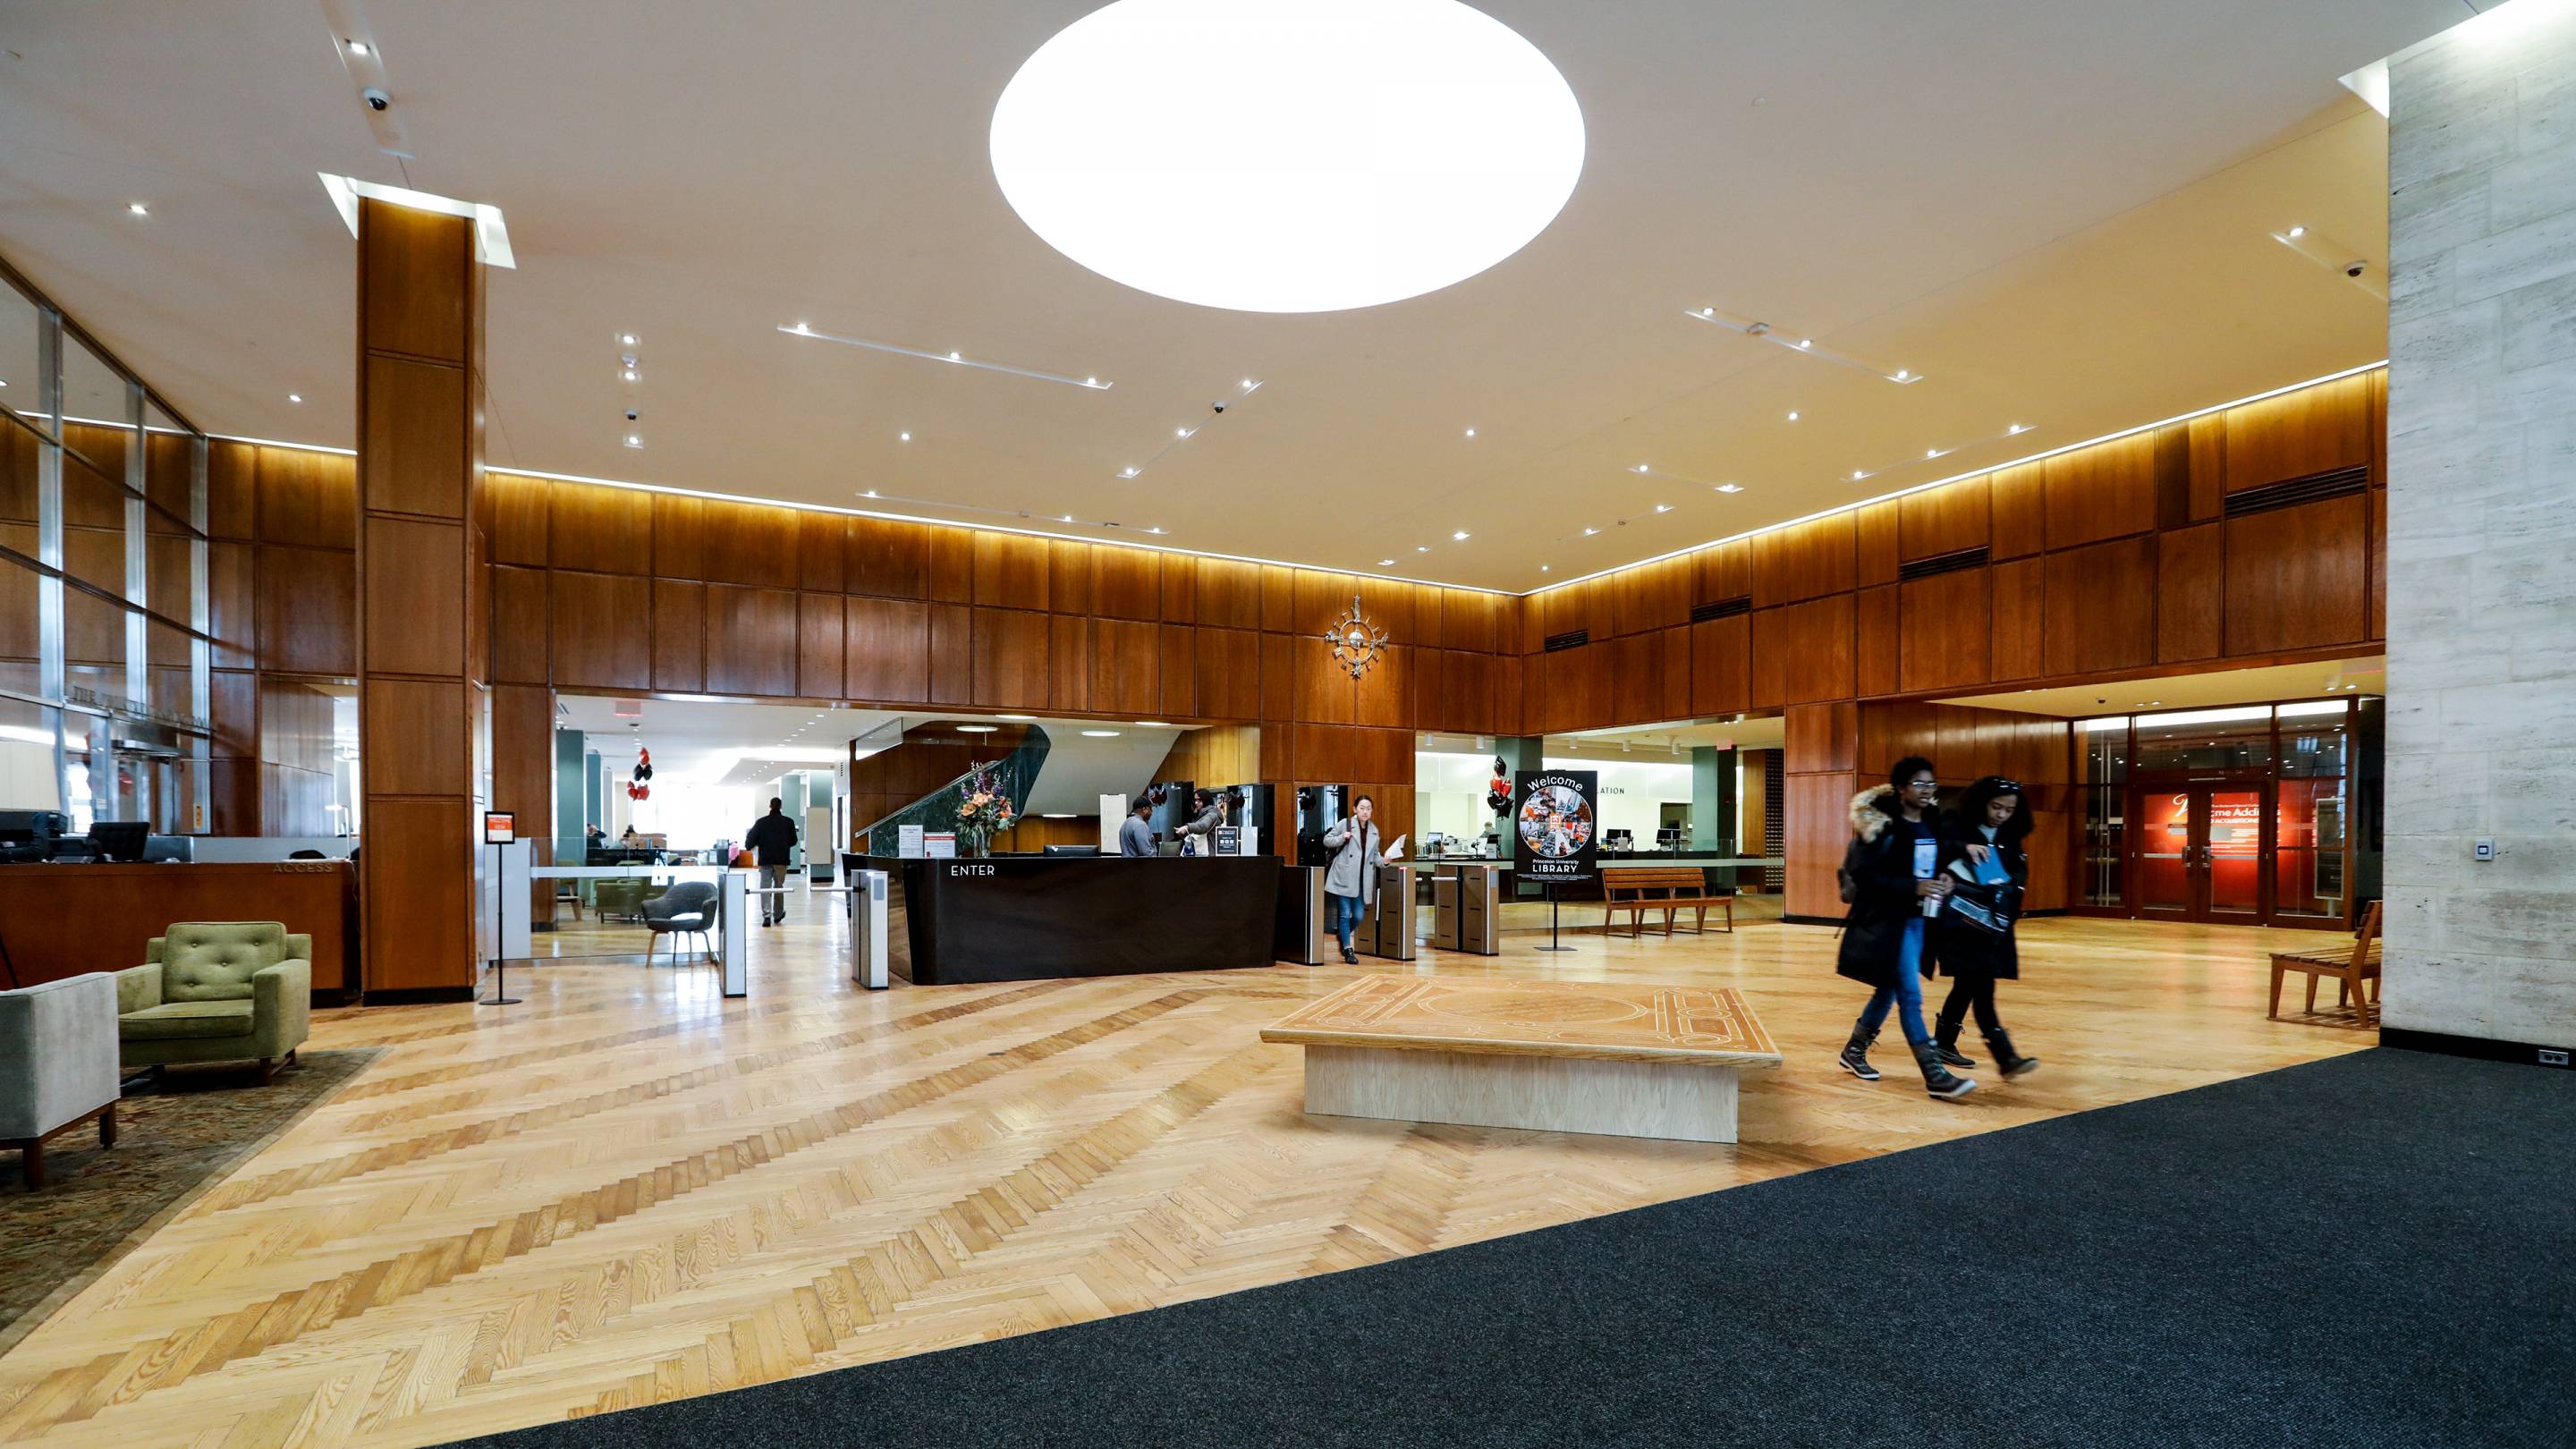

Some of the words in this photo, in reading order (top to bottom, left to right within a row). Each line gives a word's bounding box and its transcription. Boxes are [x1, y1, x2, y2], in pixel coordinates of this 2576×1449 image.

[1527, 775, 1583, 792] Welcome
[273, 862, 333, 873] ACCESS
[951, 865, 995, 877] ENTER
[1532, 864, 1578, 873] LIBRARY
